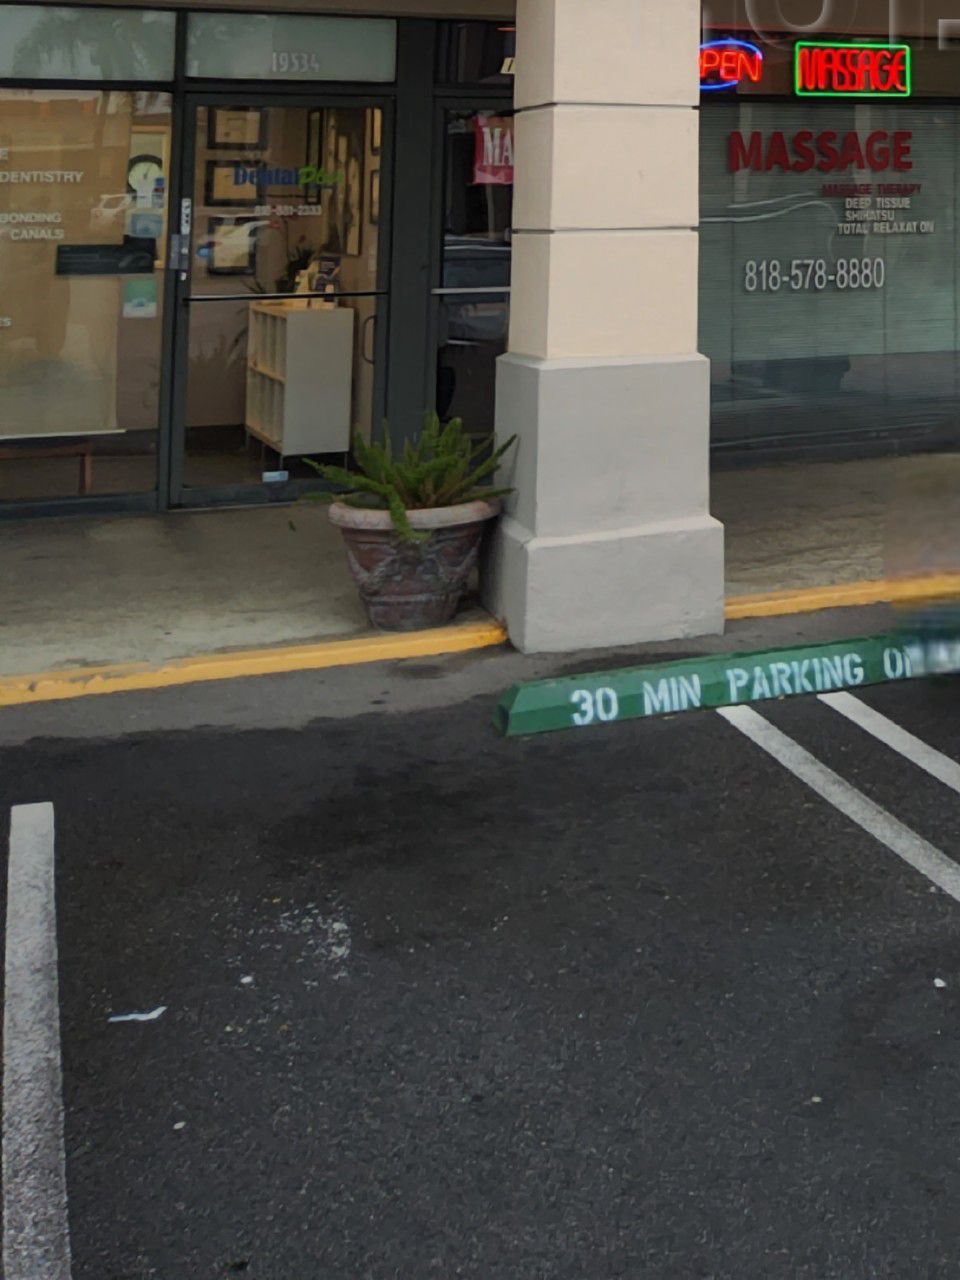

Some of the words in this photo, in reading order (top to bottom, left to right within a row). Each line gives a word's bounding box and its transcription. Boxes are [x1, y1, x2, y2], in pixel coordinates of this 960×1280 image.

[699, 49, 762, 82] PEN
[799, 48, 908, 92] MASSAGE
[728, 130, 913, 173] MASSAGE
[0, 171, 84, 183] DENTISTRY
[845, 197, 872, 209] DEEP
[875, 197, 911, 209] TISSUE
[10, 228, 65, 240] CANALS
[837, 222, 868, 234] TOTAL
[873, 221, 936, 234] RELAXATON
[744, 257, 886, 292] 818-578-8880
[571, 688, 619, 726] 30
[642, 672, 701, 717] MIN
[725, 652, 865, 702] PARKING
